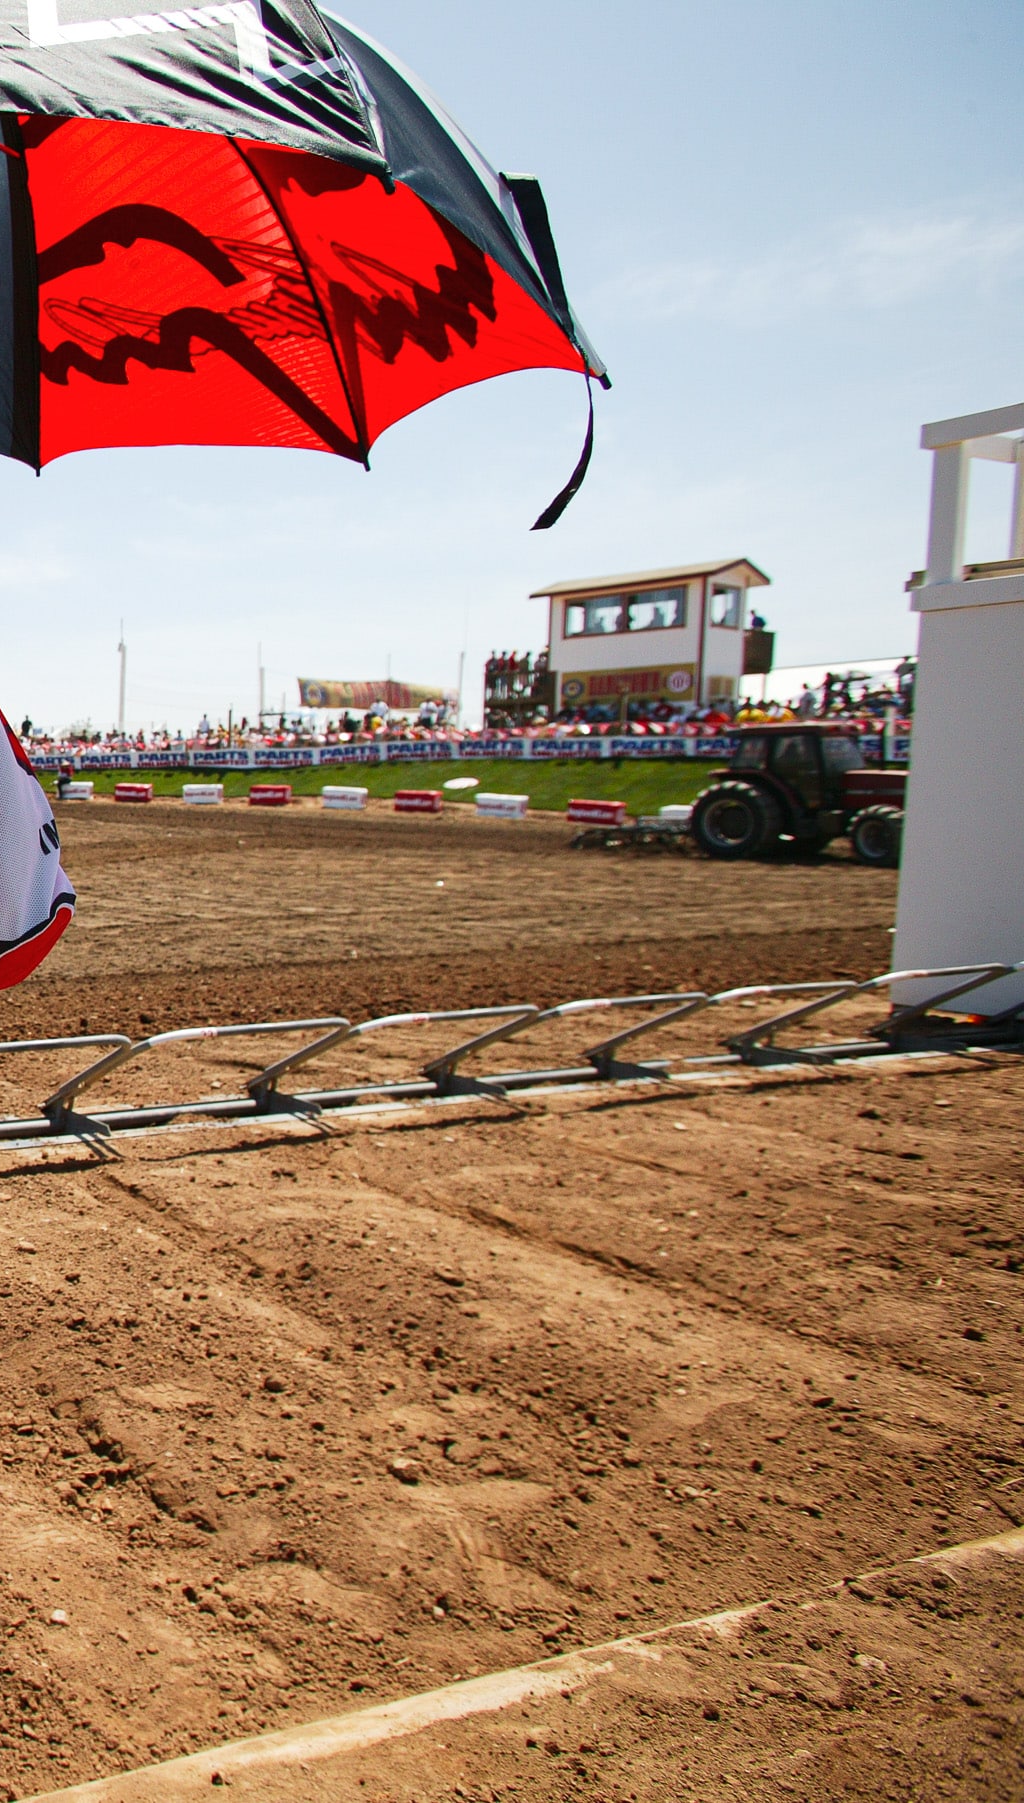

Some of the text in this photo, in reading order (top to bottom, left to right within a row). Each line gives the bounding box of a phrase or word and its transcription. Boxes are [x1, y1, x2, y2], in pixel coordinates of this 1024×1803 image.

[387, 741, 451, 752] PARTS
[459, 740, 524, 750] PARTS
[531, 739, 602, 750] PARTS
[611, 739, 686, 750] PARTS
[193, 751, 249, 760] PARTS
[254, 750, 313, 759] PARTS
[319, 745, 380, 757] PARTS
[80, 754, 131, 763] PARTS
[138, 753, 189, 762] PARTS
